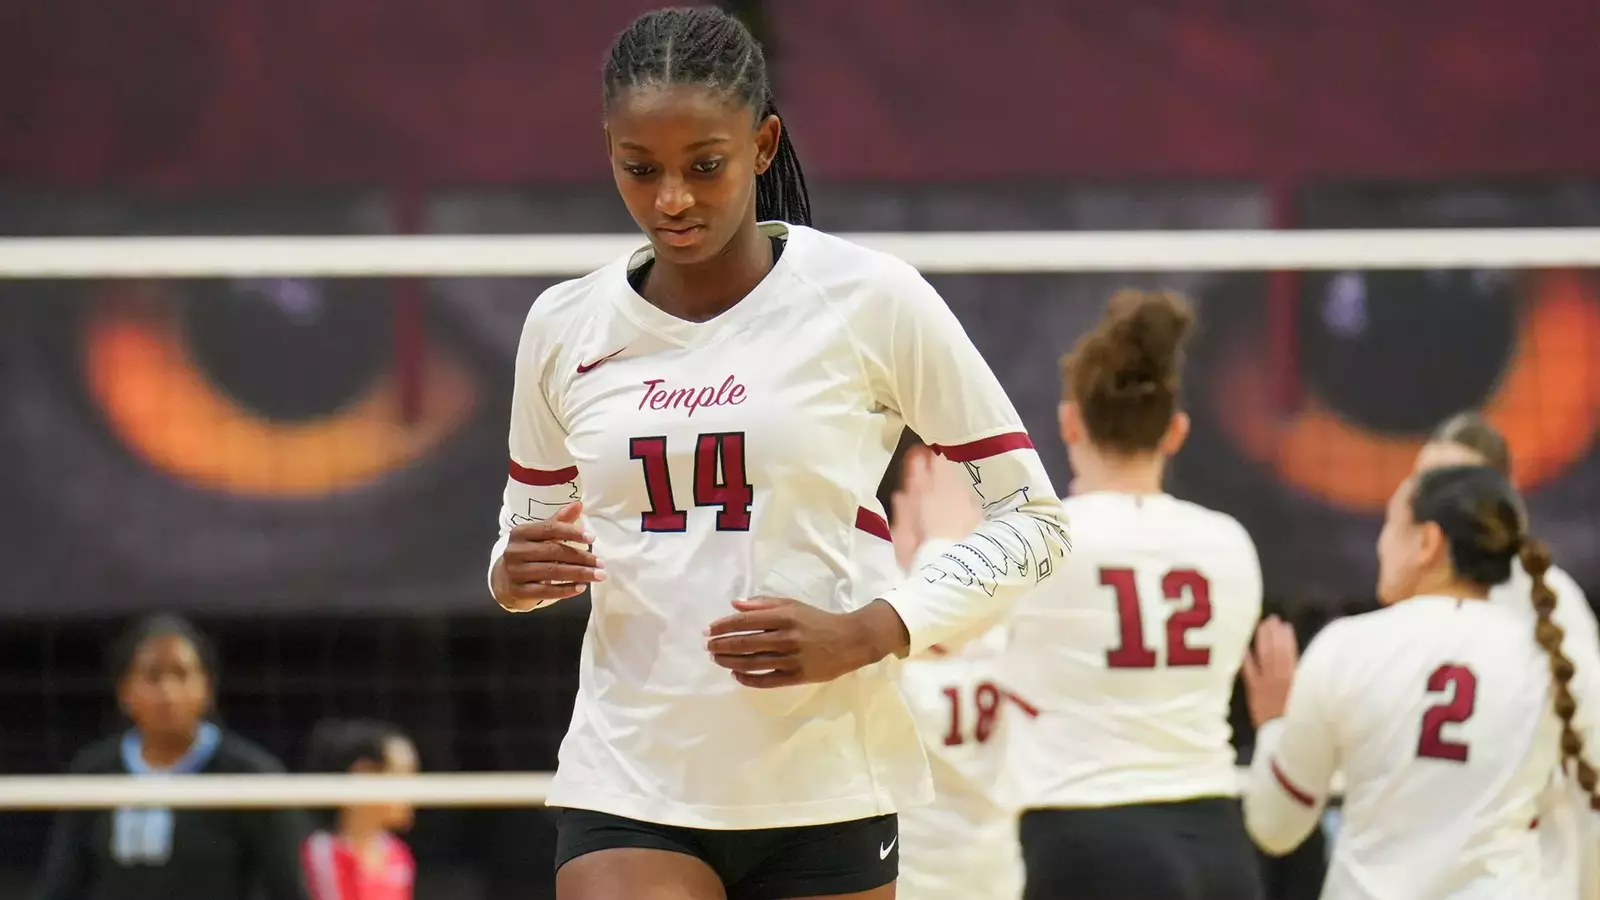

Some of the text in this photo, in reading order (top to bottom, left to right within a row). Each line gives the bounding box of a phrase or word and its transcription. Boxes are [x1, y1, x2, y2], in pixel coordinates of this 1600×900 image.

[638, 374, 747, 418] Temple
[629, 431, 753, 532] 14
[1098, 567, 1212, 668] 12
[1416, 663, 1477, 762] 2
